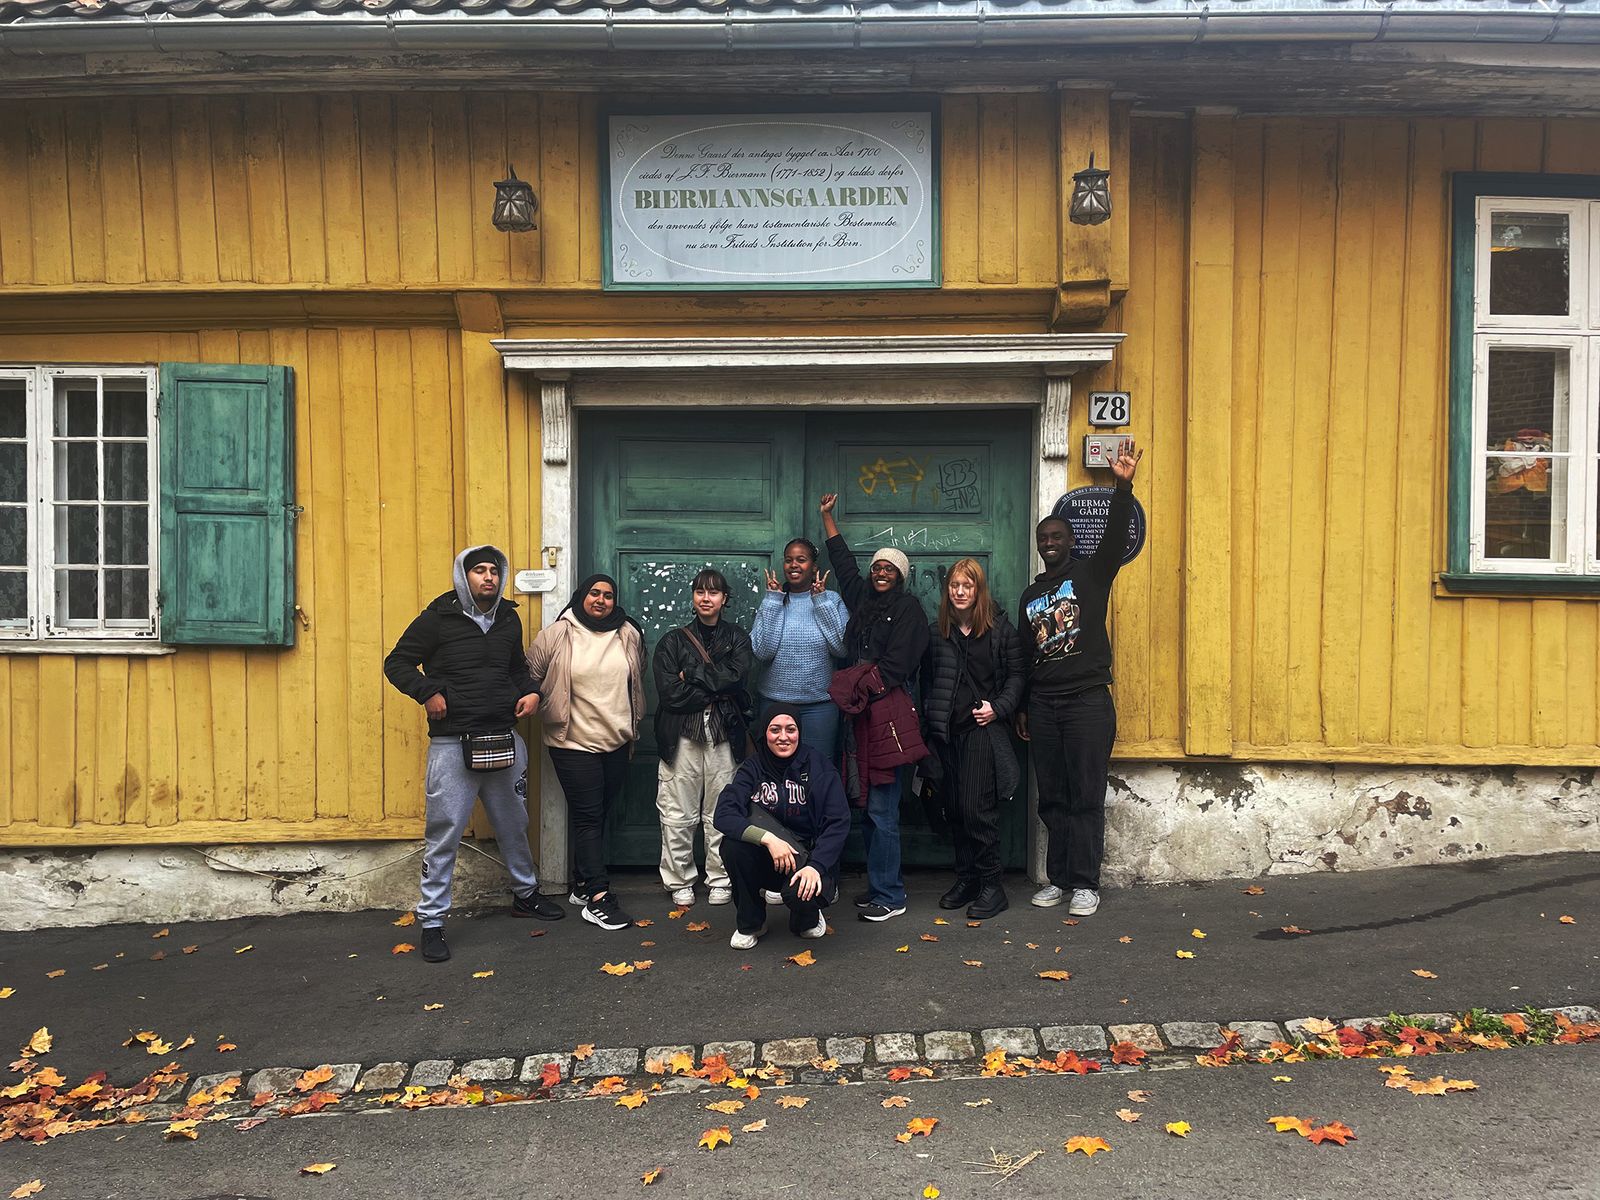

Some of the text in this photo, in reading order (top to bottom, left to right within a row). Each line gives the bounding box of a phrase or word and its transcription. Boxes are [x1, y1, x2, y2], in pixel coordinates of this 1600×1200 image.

[661, 143, 695, 159] Denne
[697, 143, 733, 159] Gaard
[732, 148, 746, 158] der
[750, 148, 783, 163] antages
[785, 146, 816, 163] bygget
[830, 141, 854, 157] Aar
[857, 147, 882, 159] 1700
[665, 168, 681, 184] af
[714, 163, 768, 180] Biermann
[834, 169, 844, 182] og
[847, 165, 875, 177] kaldes
[878, 164, 904, 180] derfor
[633, 185, 910, 211] BIERMANNSGAARDEN
[647, 218, 664, 230] den
[665, 218, 707, 230] anvendes
[736, 218, 759, 229] hans
[762, 216, 830, 229] testamentariske
[834, 211, 897, 228] Bestemmelse
[760, 232, 812, 249] Institution
[812, 235, 829, 252] for
[1094, 395, 1126, 421] 78
